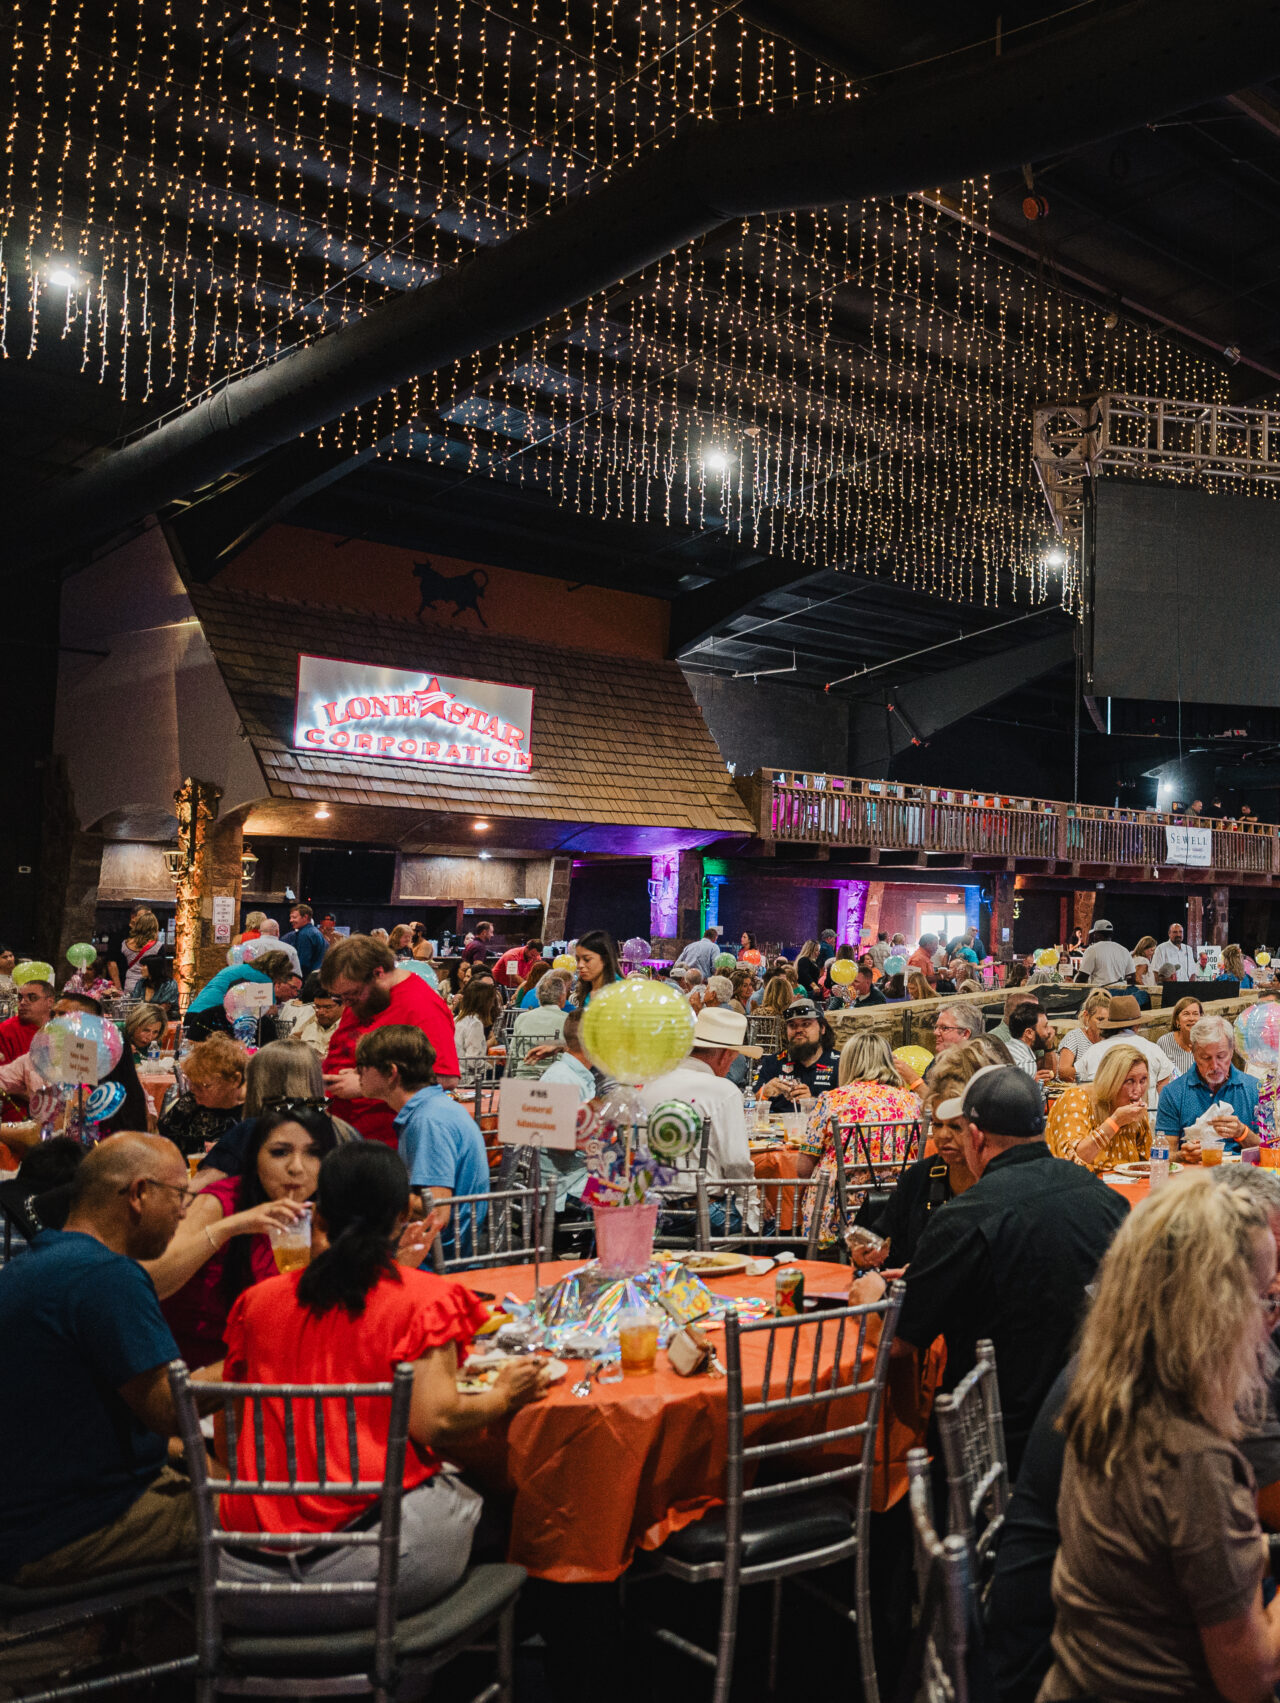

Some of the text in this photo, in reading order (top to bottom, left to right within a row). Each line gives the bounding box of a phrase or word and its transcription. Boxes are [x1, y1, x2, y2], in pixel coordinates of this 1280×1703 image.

[322, 694, 526, 751] LONE STAR
[306, 728, 533, 767] CORPORATION
[521, 1103, 553, 1115] General
[516, 1119, 556, 1131] Admission
